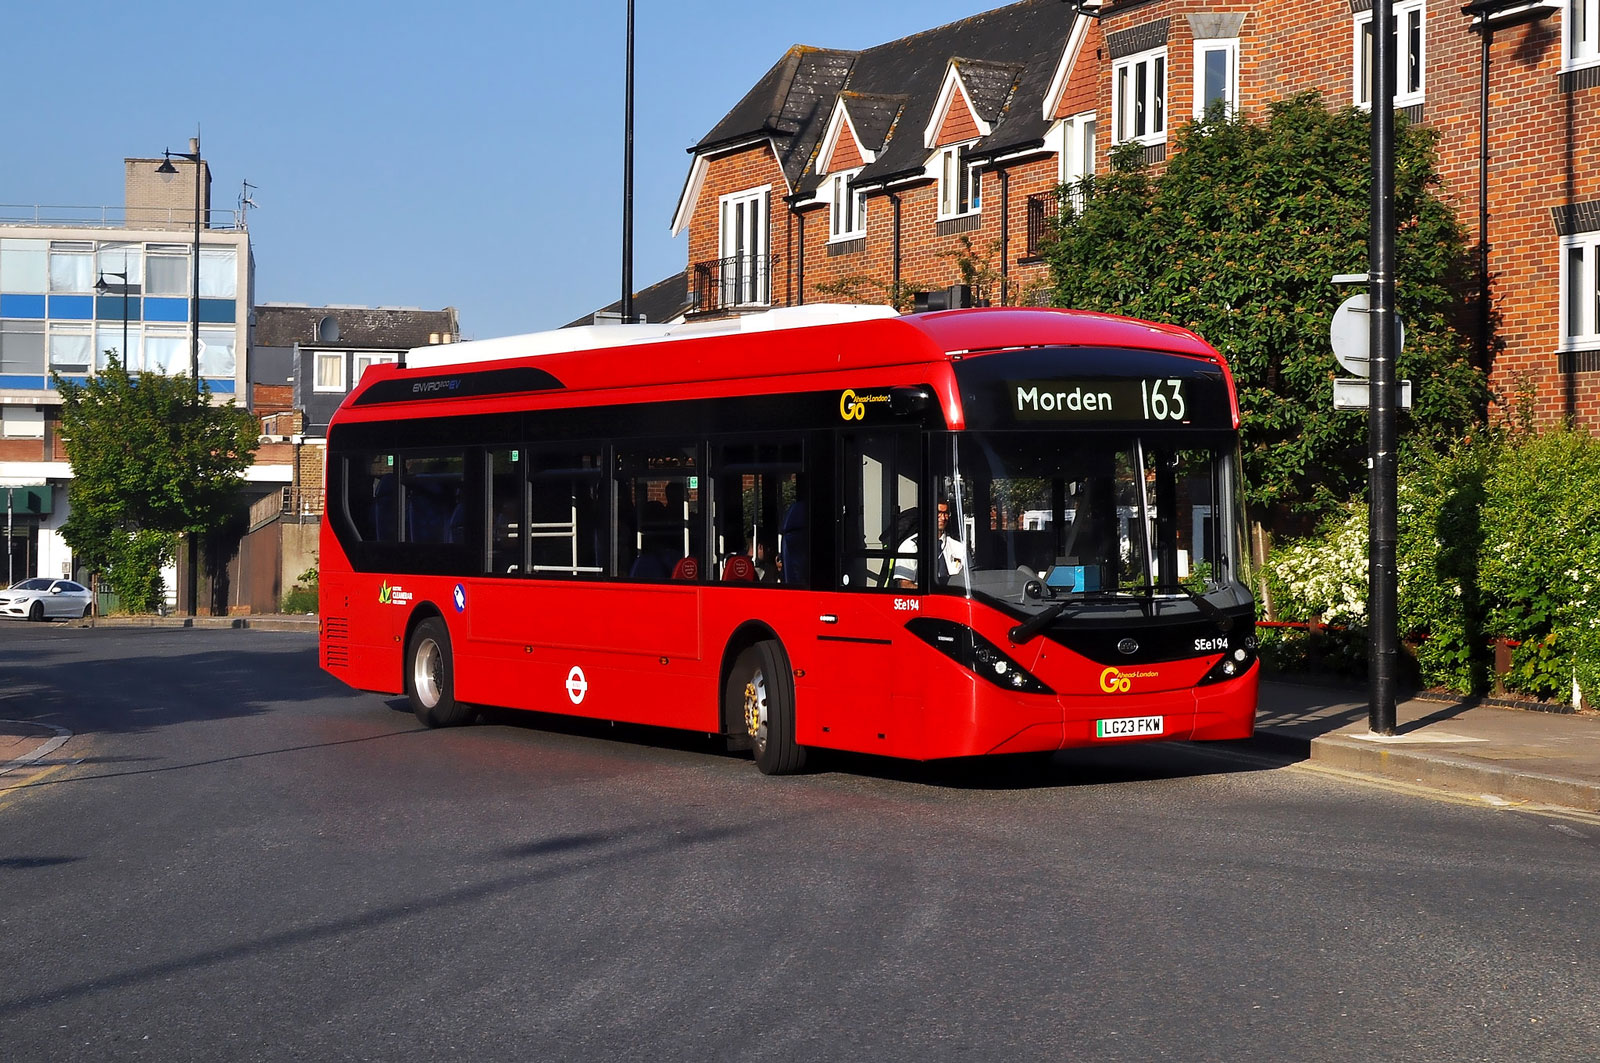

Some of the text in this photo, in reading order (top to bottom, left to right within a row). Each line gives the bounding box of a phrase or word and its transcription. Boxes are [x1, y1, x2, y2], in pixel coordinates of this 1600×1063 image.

[840, 388, 866, 421] Go
[1016, 379, 1186, 421] Morden 163
[893, 598, 919, 611] SEe194
[1194, 638, 1229, 651] SEe194
[1100, 666, 1131, 693] Go
[1104, 717, 1160, 735] LG23 FKW
